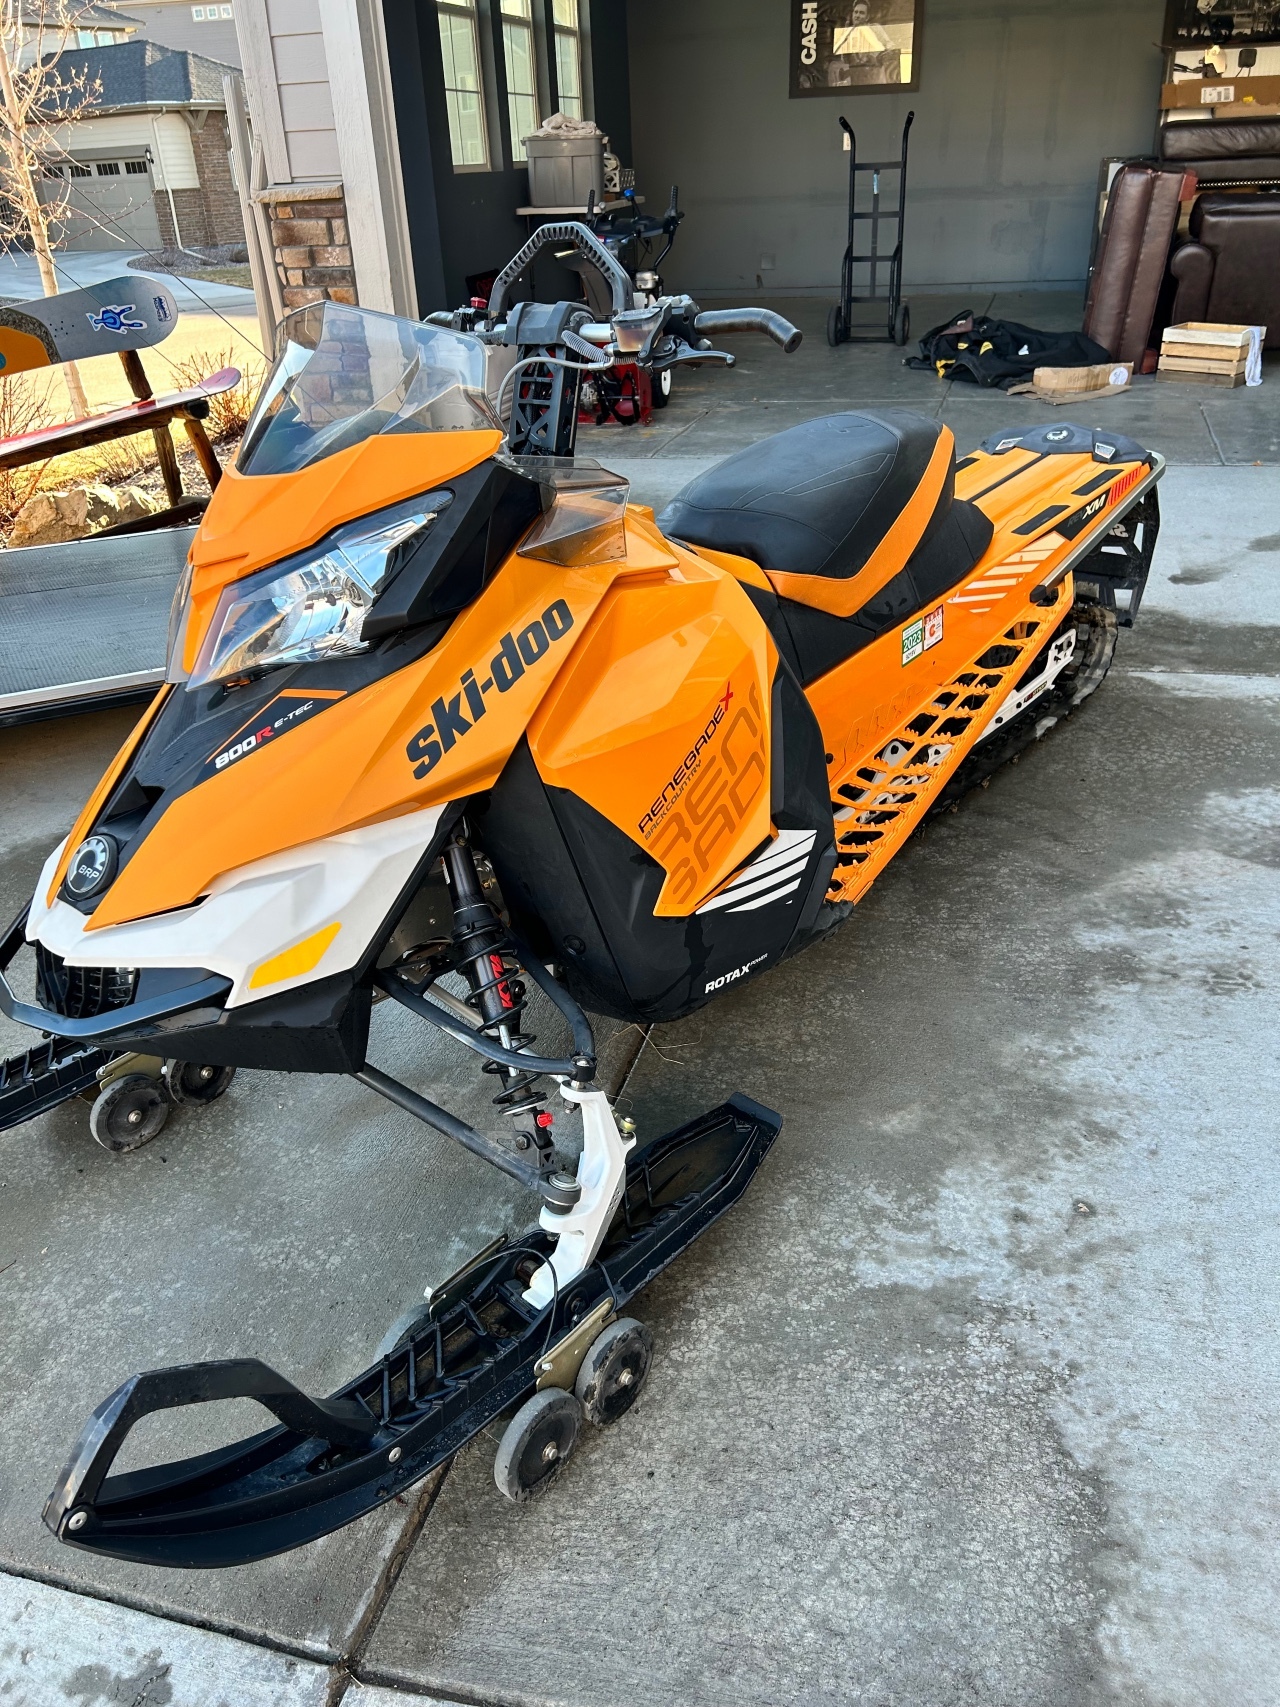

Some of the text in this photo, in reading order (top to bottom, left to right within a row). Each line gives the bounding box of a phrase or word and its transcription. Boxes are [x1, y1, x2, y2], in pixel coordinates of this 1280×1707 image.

[801, 2, 818, 65] CASH
[903, 630, 922, 653] 2023
[406, 598, 574, 780] ski-doo
[214, 700, 314, 769] 800R E-TEC
[645, 759, 702, 840] BACKCOUNTRY
[78, 864, 100, 879] BRP
[704, 961, 751, 994] ROTAX
